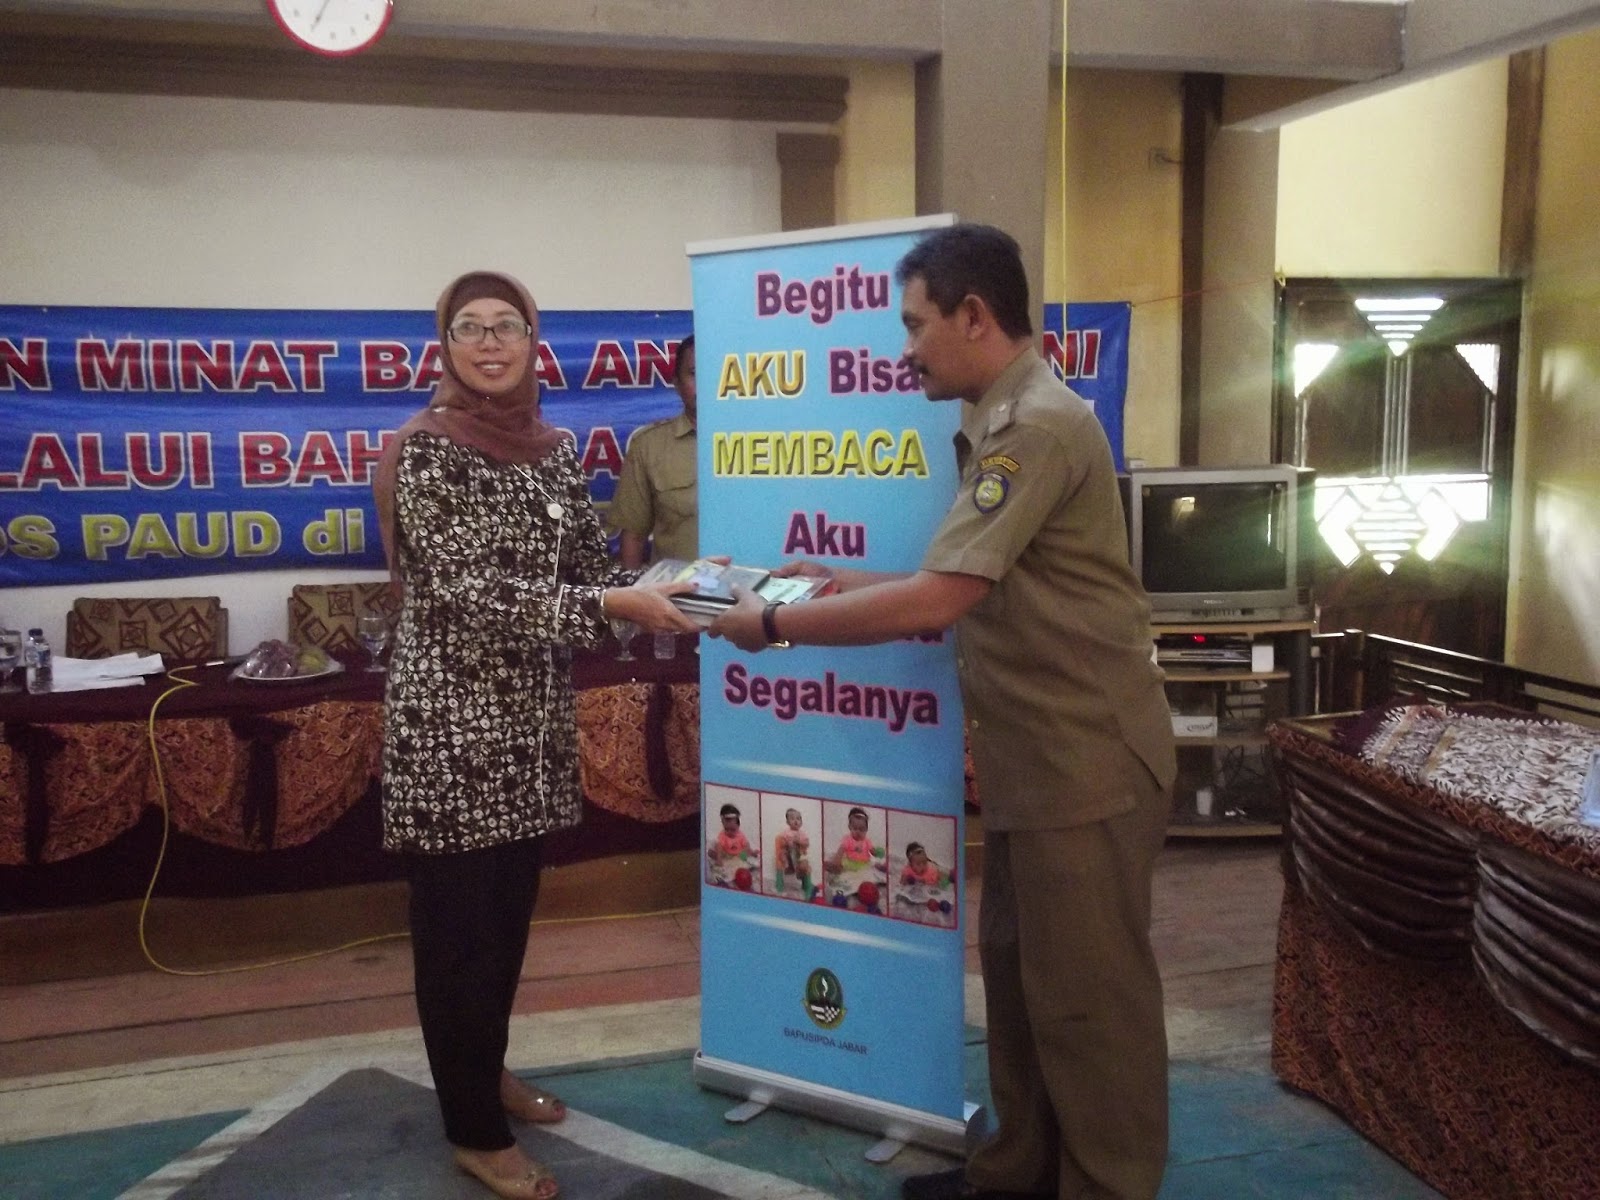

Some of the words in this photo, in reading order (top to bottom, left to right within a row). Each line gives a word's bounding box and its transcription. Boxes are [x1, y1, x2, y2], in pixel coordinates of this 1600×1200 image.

[755, 264, 891, 327] Begitu
[76, 338, 338, 393] MINAT
[360, 340, 567, 392] BAA
[717, 350, 805, 399] AKU
[827, 347, 924, 397] Bisa
[713, 429, 930, 479] MEMBACA
[0, 514, 60, 560] S
[81, 511, 281, 561] PAUD
[303, 508, 365, 555] di
[783, 511, 868, 559] Aku
[724, 663, 941, 733] Segalanya
[837, 1040, 868, 1055] JABAR
